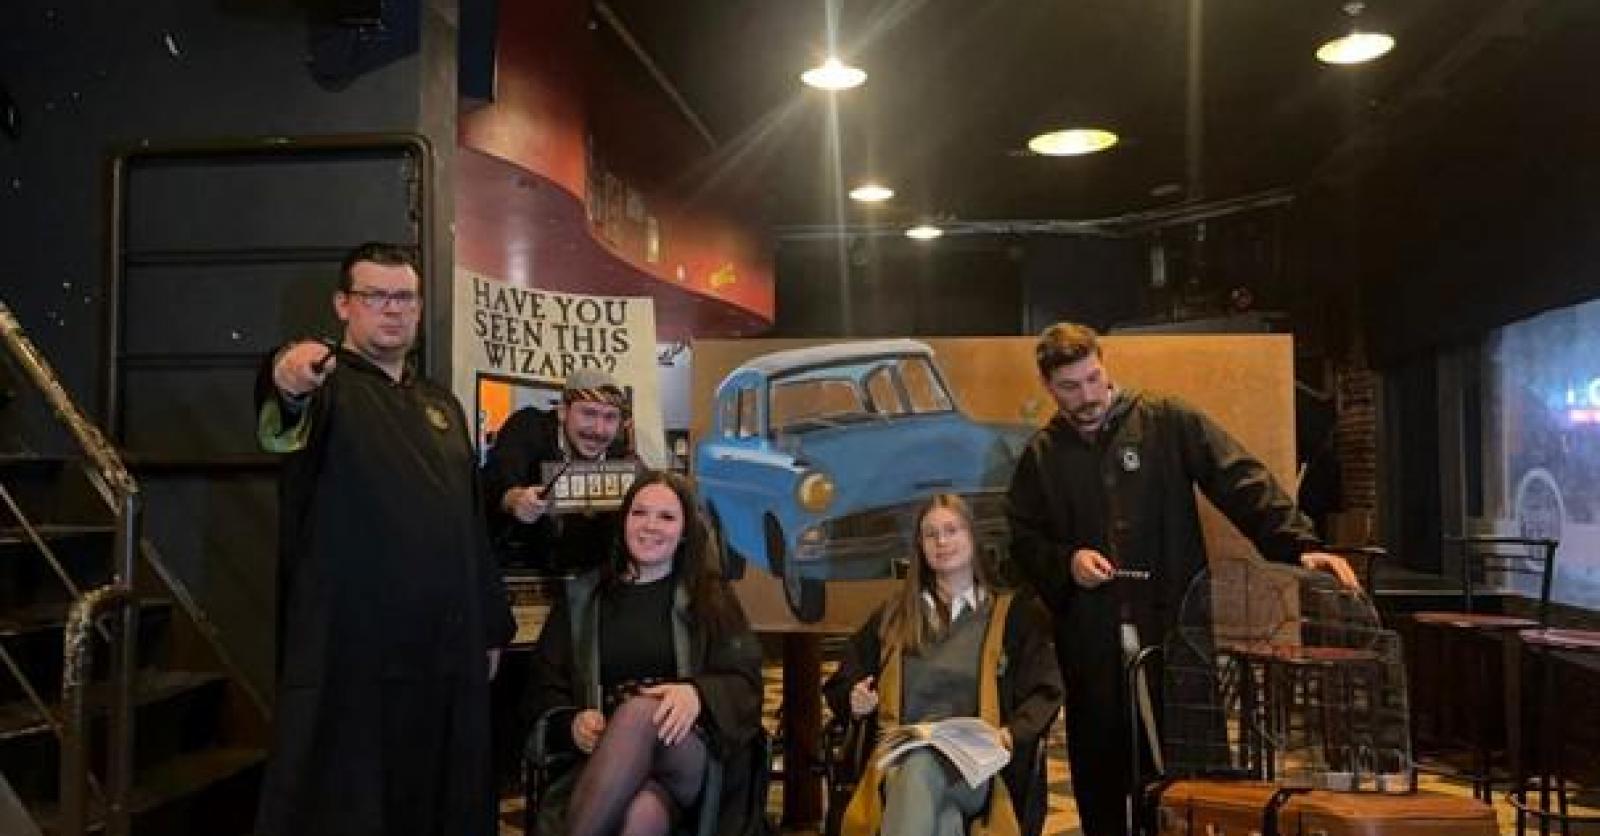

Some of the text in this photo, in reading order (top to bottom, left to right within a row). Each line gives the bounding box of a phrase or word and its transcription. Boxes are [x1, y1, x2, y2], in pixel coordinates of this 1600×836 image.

[474, 277, 628, 325] HAVE YOU
[475, 309, 630, 352] SEEN THIS
